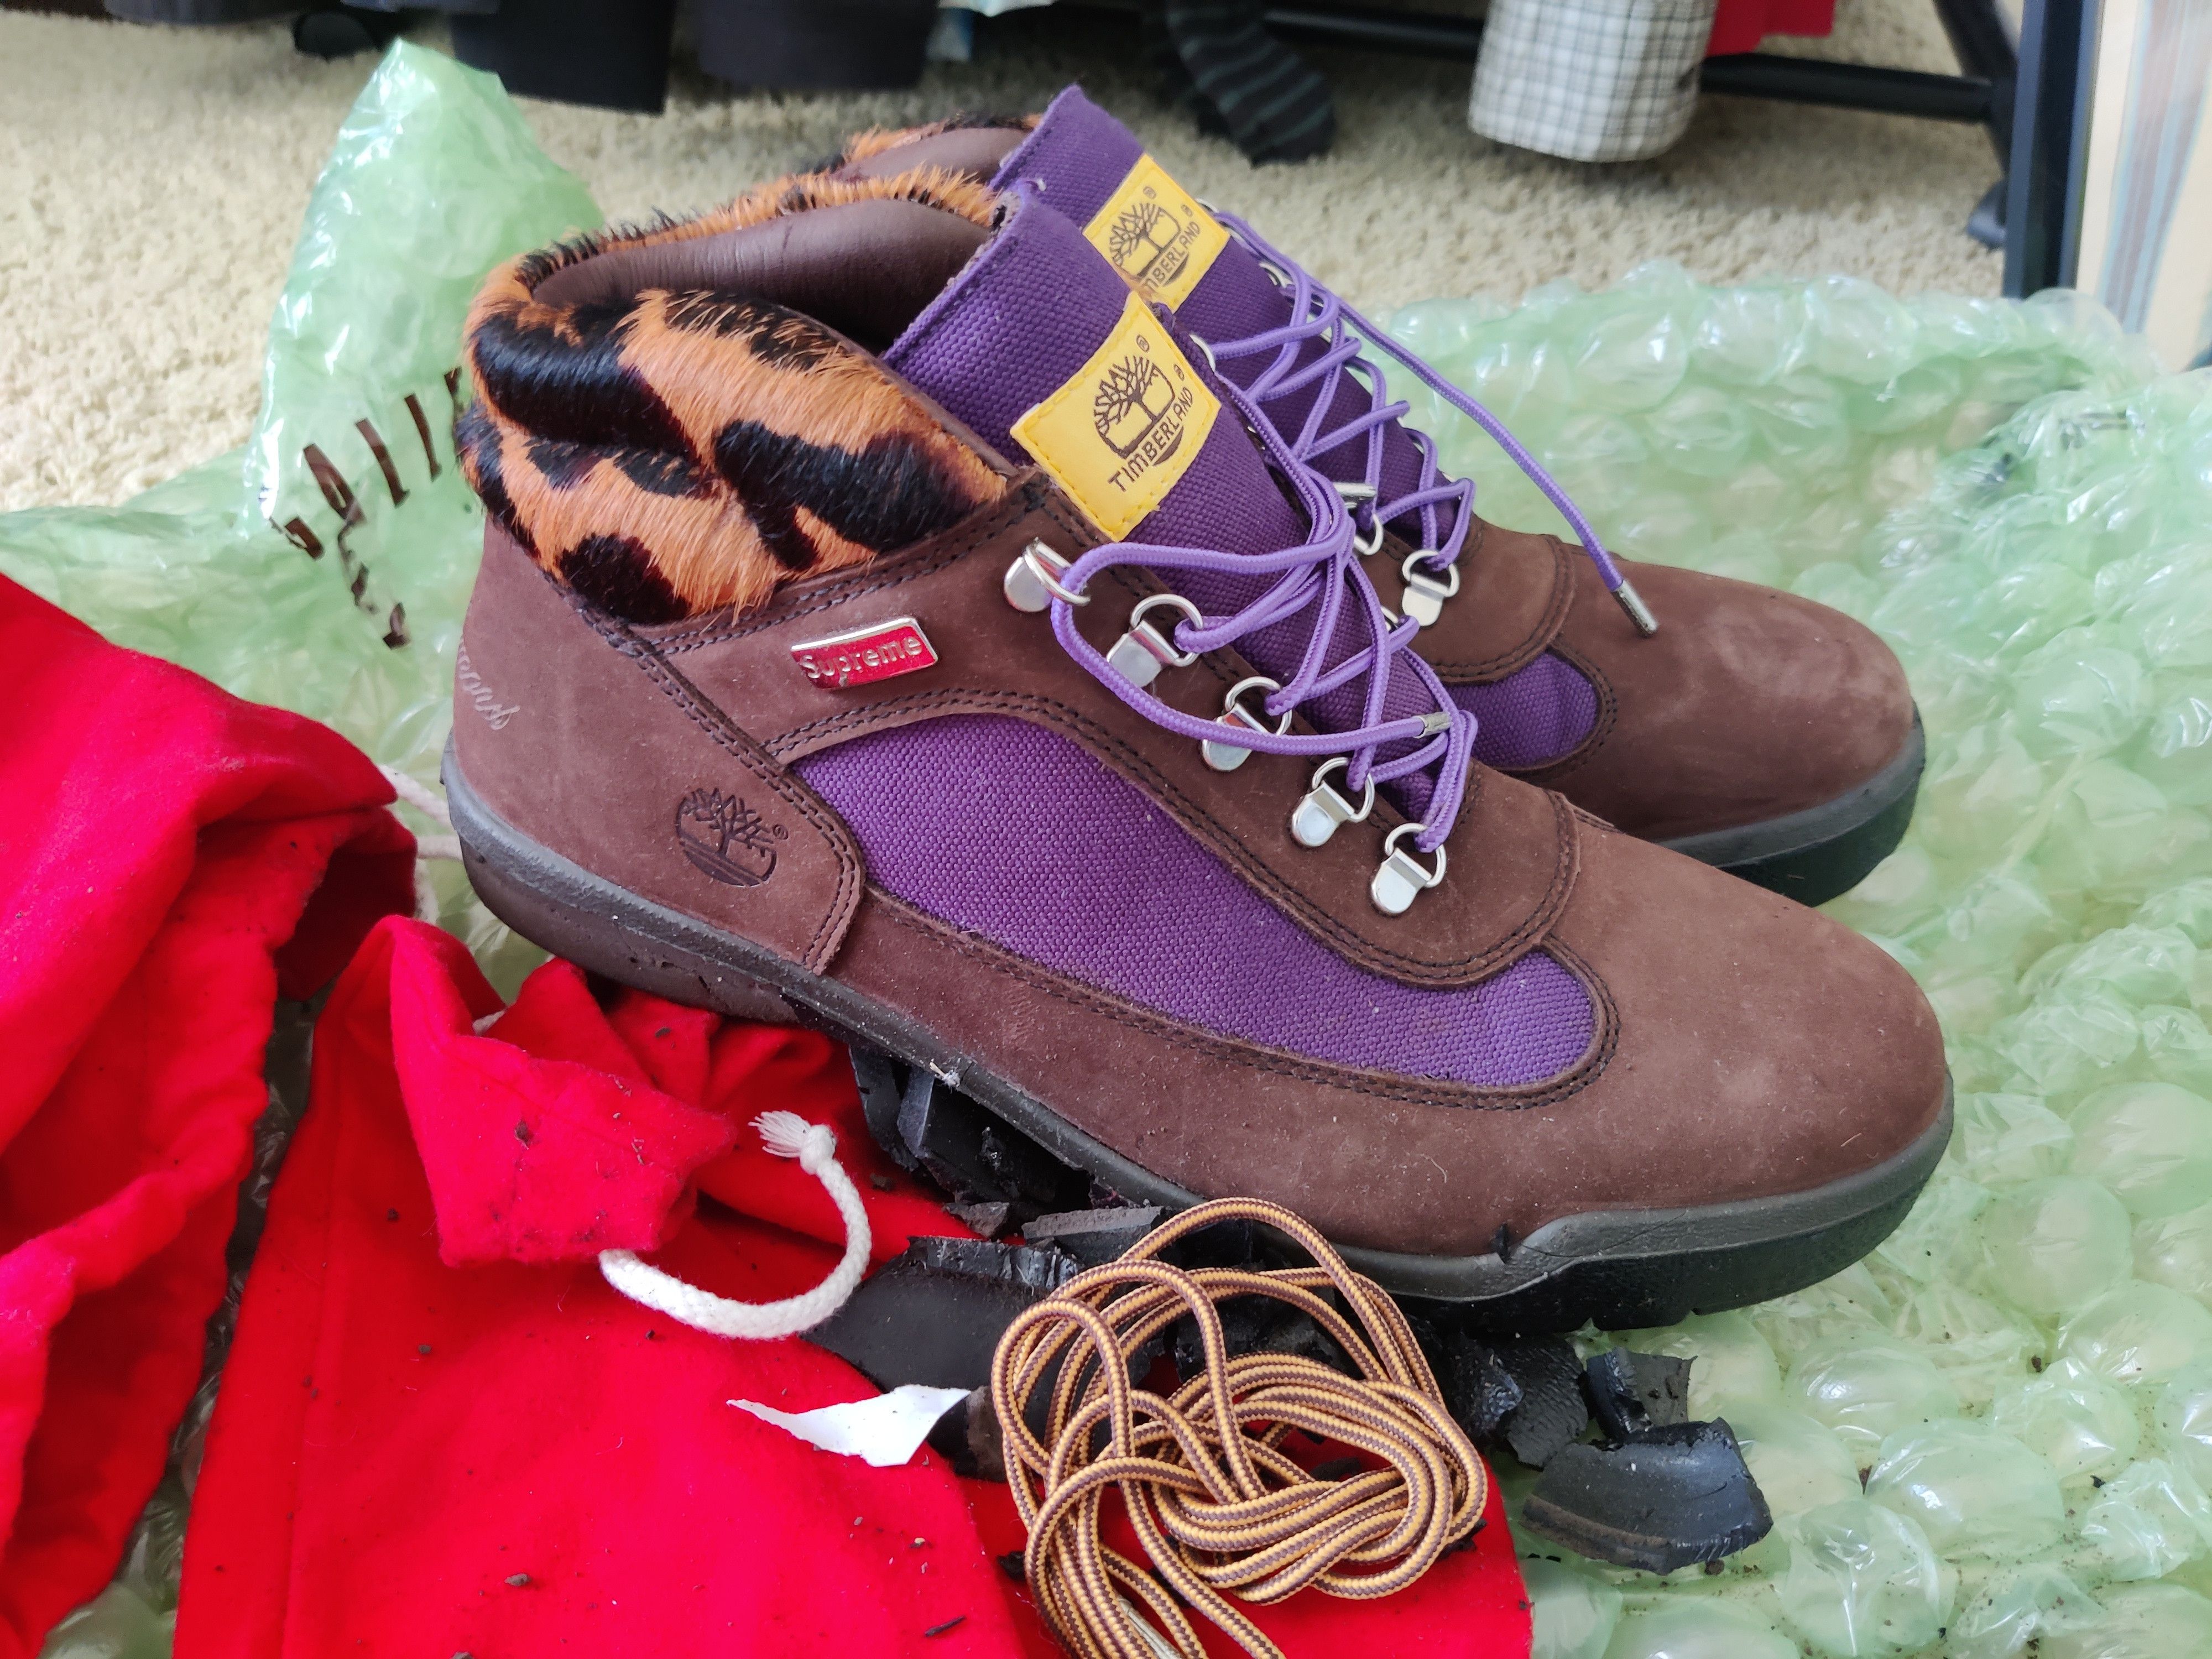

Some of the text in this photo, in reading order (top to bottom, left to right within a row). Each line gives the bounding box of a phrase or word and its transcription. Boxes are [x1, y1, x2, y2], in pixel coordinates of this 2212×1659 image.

[1142, 221, 1201, 290] MBERLAND
[1108, 387, 1193, 492] TIMBERLAND
[800, 636, 923, 687] Supreme
